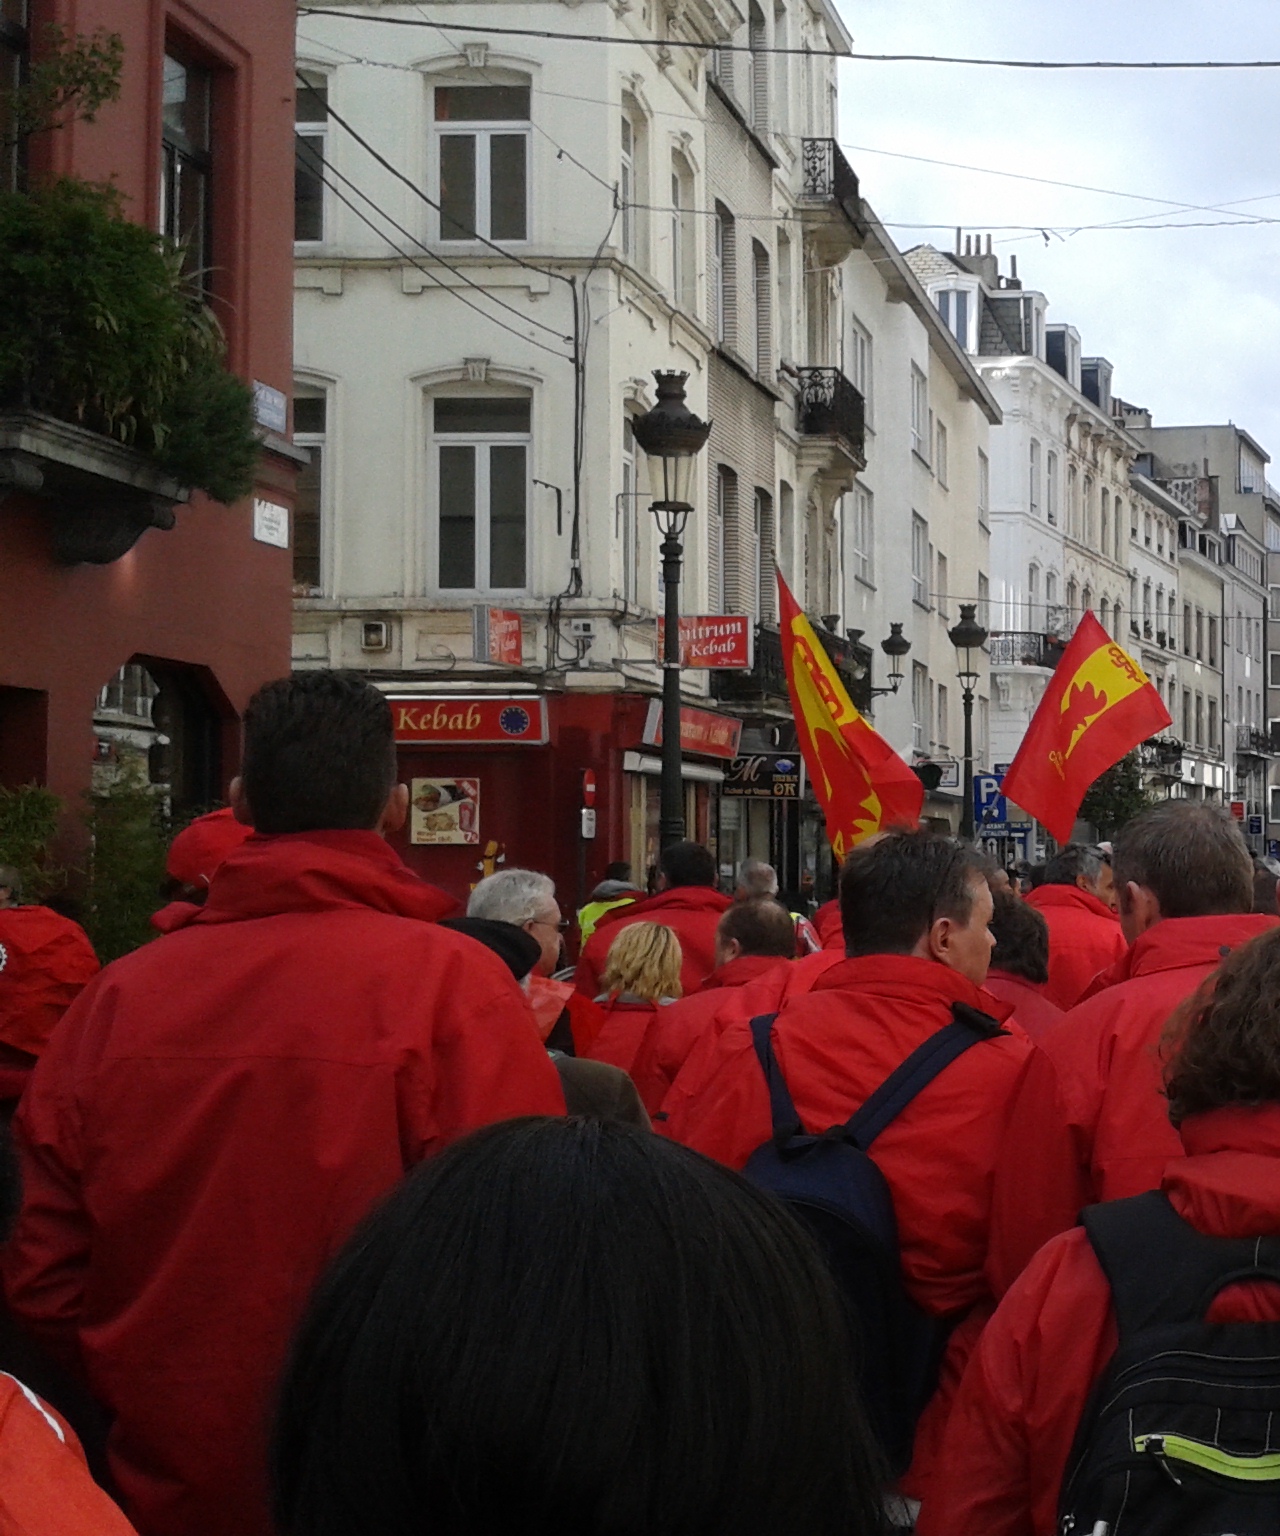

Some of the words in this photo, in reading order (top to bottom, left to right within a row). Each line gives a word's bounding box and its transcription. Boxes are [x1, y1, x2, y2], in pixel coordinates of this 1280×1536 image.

[691, 636, 736, 657] Kebab
[397, 703, 481, 730] Kebab
[773, 783, 796, 796] OK
[980, 778, 999, 803] P
